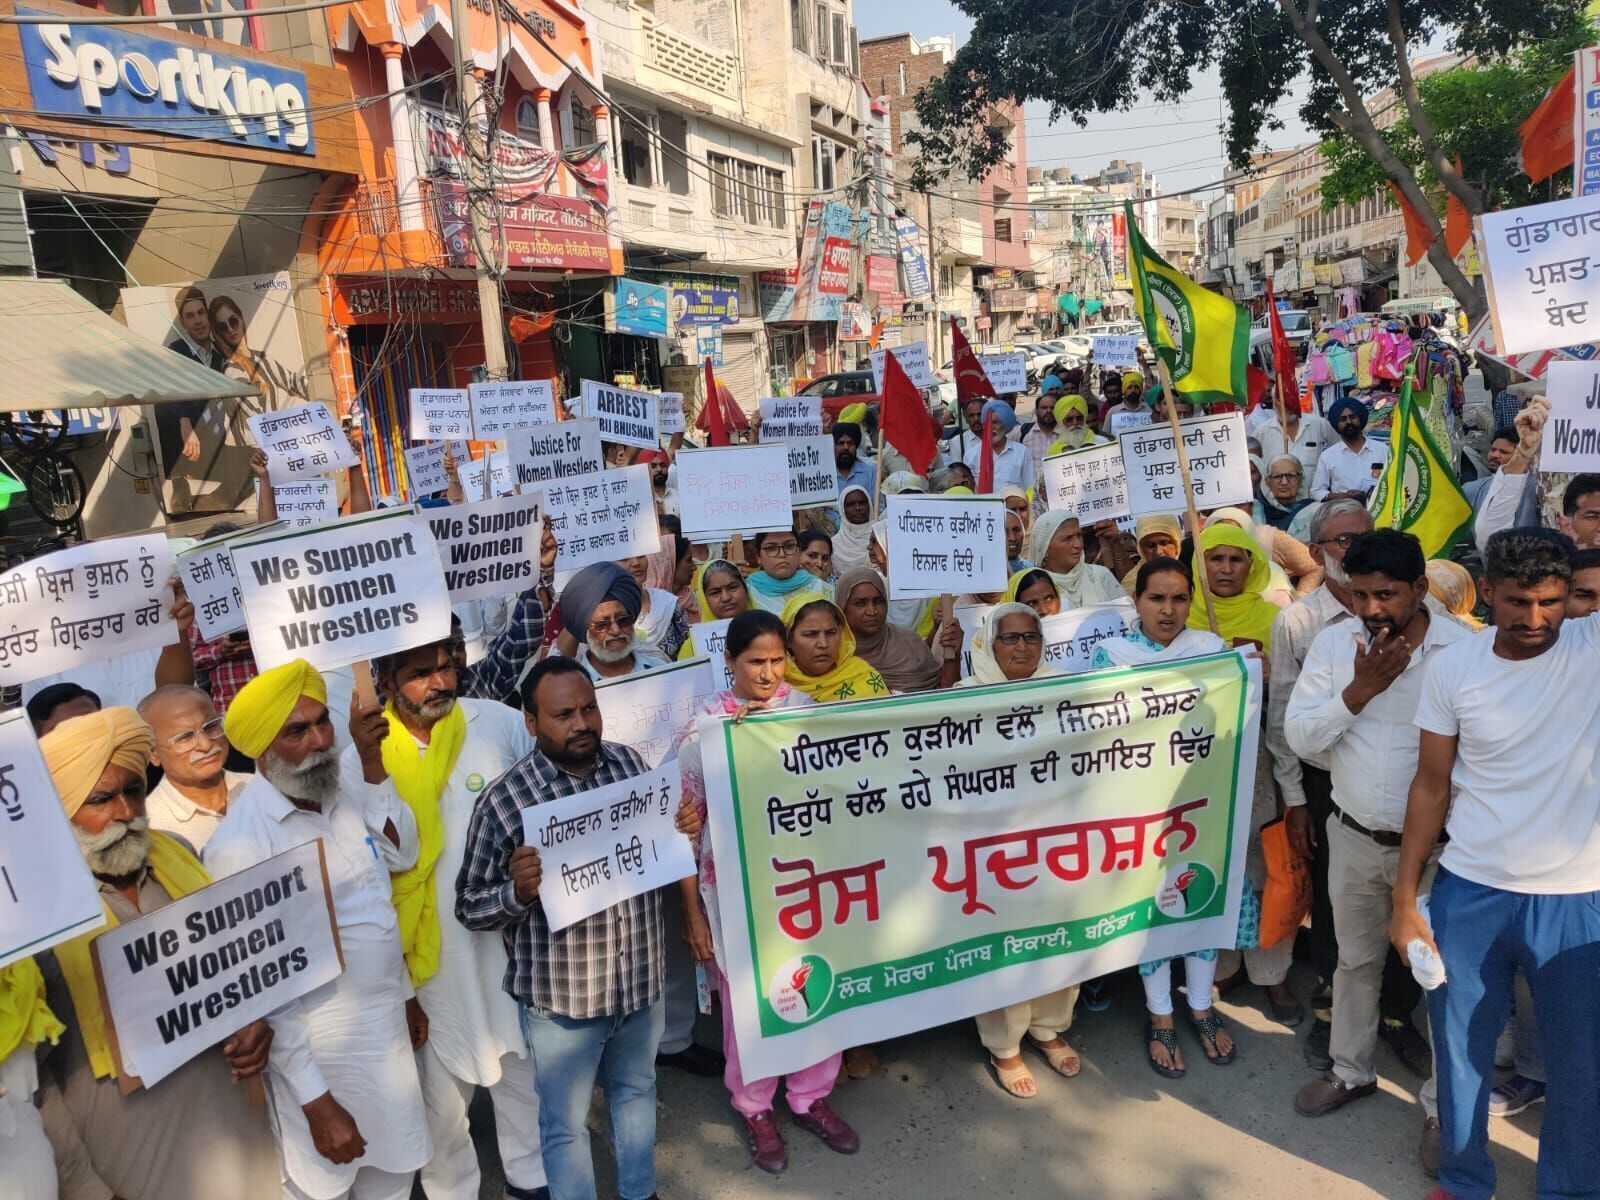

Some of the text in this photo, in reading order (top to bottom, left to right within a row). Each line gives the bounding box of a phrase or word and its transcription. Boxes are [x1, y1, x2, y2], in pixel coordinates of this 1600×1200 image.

[38, 23, 310, 147] Sportking
[627, 293, 638, 306] Jio
[1545, 298, 1589, 327] ਬੰਦ
[597, 389, 648, 419] ARREST
[773, 402, 810, 419] Justice For
[259, 408, 313, 437] ਗੁੰਡਾਗਰਦੀ
[600, 417, 654, 441] RIJ BHUSHAN
[762, 421, 819, 438] Women Wrestlers
[1555, 419, 1600, 454] Wom
[529, 431, 581, 457] Justice For
[1133, 425, 1231, 457] ਗੁੰਡਾਗਦੀ ਦੀ
[287, 457, 305, 472] ਬੰਦ
[311, 450, 329, 465] ਕਰੋ
[516, 456, 599, 484] Women Wrestlers
[788, 445, 819, 469] stice For
[274, 483, 329, 496] ਡਾਗਰਦੀ ਦੀ
[797, 471, 833, 494] Wrestlers
[1152, 483, 1175, 501] ਬੰਦ
[429, 504, 539, 540] We Support
[898, 509, 995, 541] ਪਹਿਲਵਾਨ ਕੁੜੀਆਂ ਨੂੰ
[251, 532, 417, 587] We Support
[451, 536, 523, 565] Women
[912, 547, 948, 572] ਇਨਸਾਫ
[36, 566, 73, 602] ਬ੍ਰਿਜ
[84, 559, 129, 599] ਭੂਸ਼ਨ
[139, 546, 155, 588] ਨੂੰ
[189, 556, 216, 584] ਦੋਸ਼ੀ
[287, 572, 397, 614] Women
[135, 599, 162, 627] ਕਰੋ
[200, 594, 230, 625] ਤੁਰੰਤ
[279, 601, 419, 651] Wrestlers
[1045, 640, 1074, 662] ਲਵਾਨ
[781, 686, 1200, 775] ਪਹਿਲਵਾਨ ਕੁੜੀਆਂ ਵੱਲੋਂ ਜਿਨਸੀ ਸ਼ੋਸ਼ਣ
[767, 725, 1215, 837] ਵਿਰੁੱਧ ਚੱਲ ਰਹੇ ਸੰਘਰਸ਼ ਦੀ ਹਮਾਇਤ ਵਿੱਚ
[538, 777, 671, 849] ਪਹਿਲਵਾਨ ਕੁੜੀਆਂ ਨੂੰ
[561, 853, 610, 897] ਇਨਸਾਫ
[771, 798, 1208, 940] ਰੋਸ ਪ੍ਰਦਰਸ਼ਨ
[122, 865, 309, 976] We Support
[165, 917, 287, 998] Women
[838, 975, 873, 999] ਲੋਕ
[884, 961, 934, 988] ਮੋਰਚਾ
[945, 944, 993, 971] ਪੰਜਾਬ
[1085, 911, 1136, 939] ਬਠਿੰਡਾ
[155, 945, 310, 1046] Wrestlers
